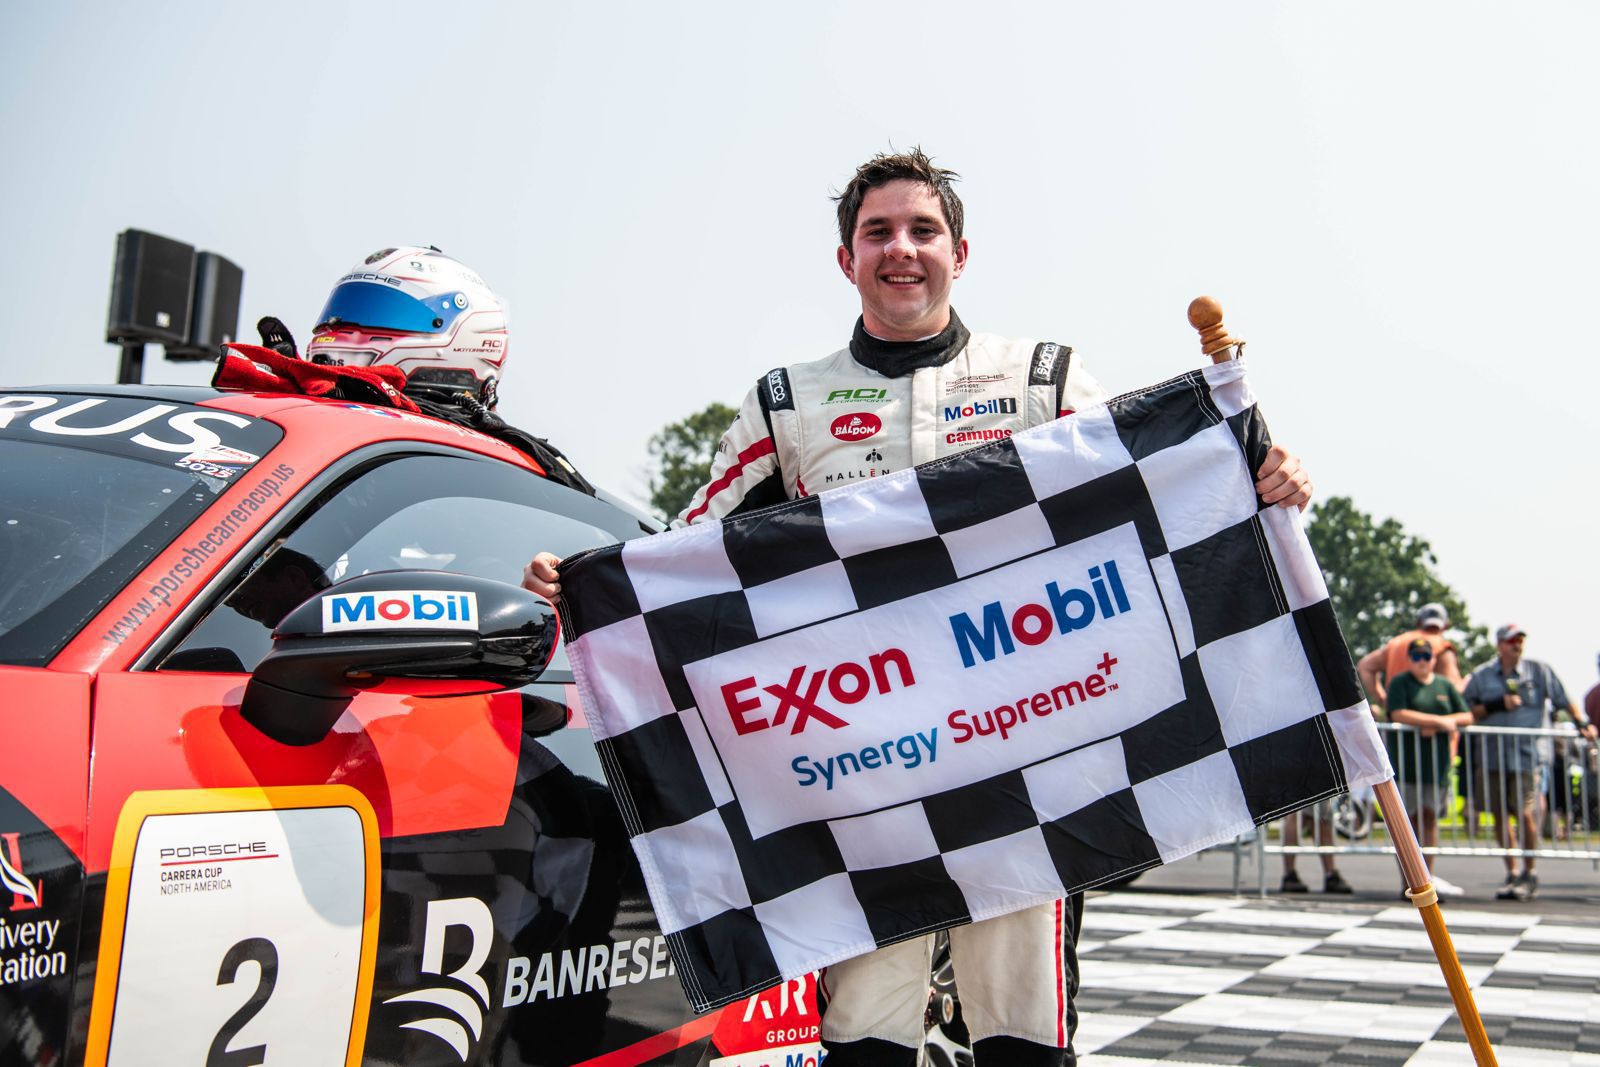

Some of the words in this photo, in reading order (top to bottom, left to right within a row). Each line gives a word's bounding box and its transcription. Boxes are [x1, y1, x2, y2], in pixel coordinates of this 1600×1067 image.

[827, 388, 888, 402] ACI
[944, 399, 998, 422] Mobil
[833, 424, 877, 437] BALDOM
[945, 429, 1013, 445] campos
[174, 459, 233, 478] 2025
[102, 463, 296, 646] www.porschecarreracup.us
[331, 594, 470, 624] Mobil
[720, 647, 916, 736] Exxon
[948, 559, 1132, 669] Mobil
[791, 727, 939, 791] Synergy
[159, 841, 267, 859] PORSCHE
[160, 869, 203, 882] CARRERA
[204, 867, 223, 879] CUP
[160, 882, 191, 896] NORTH
[193, 879, 232, 892] AMERICA
[205, 936, 279, 1067] 2
[766, 1025, 819, 1043] GROUP
